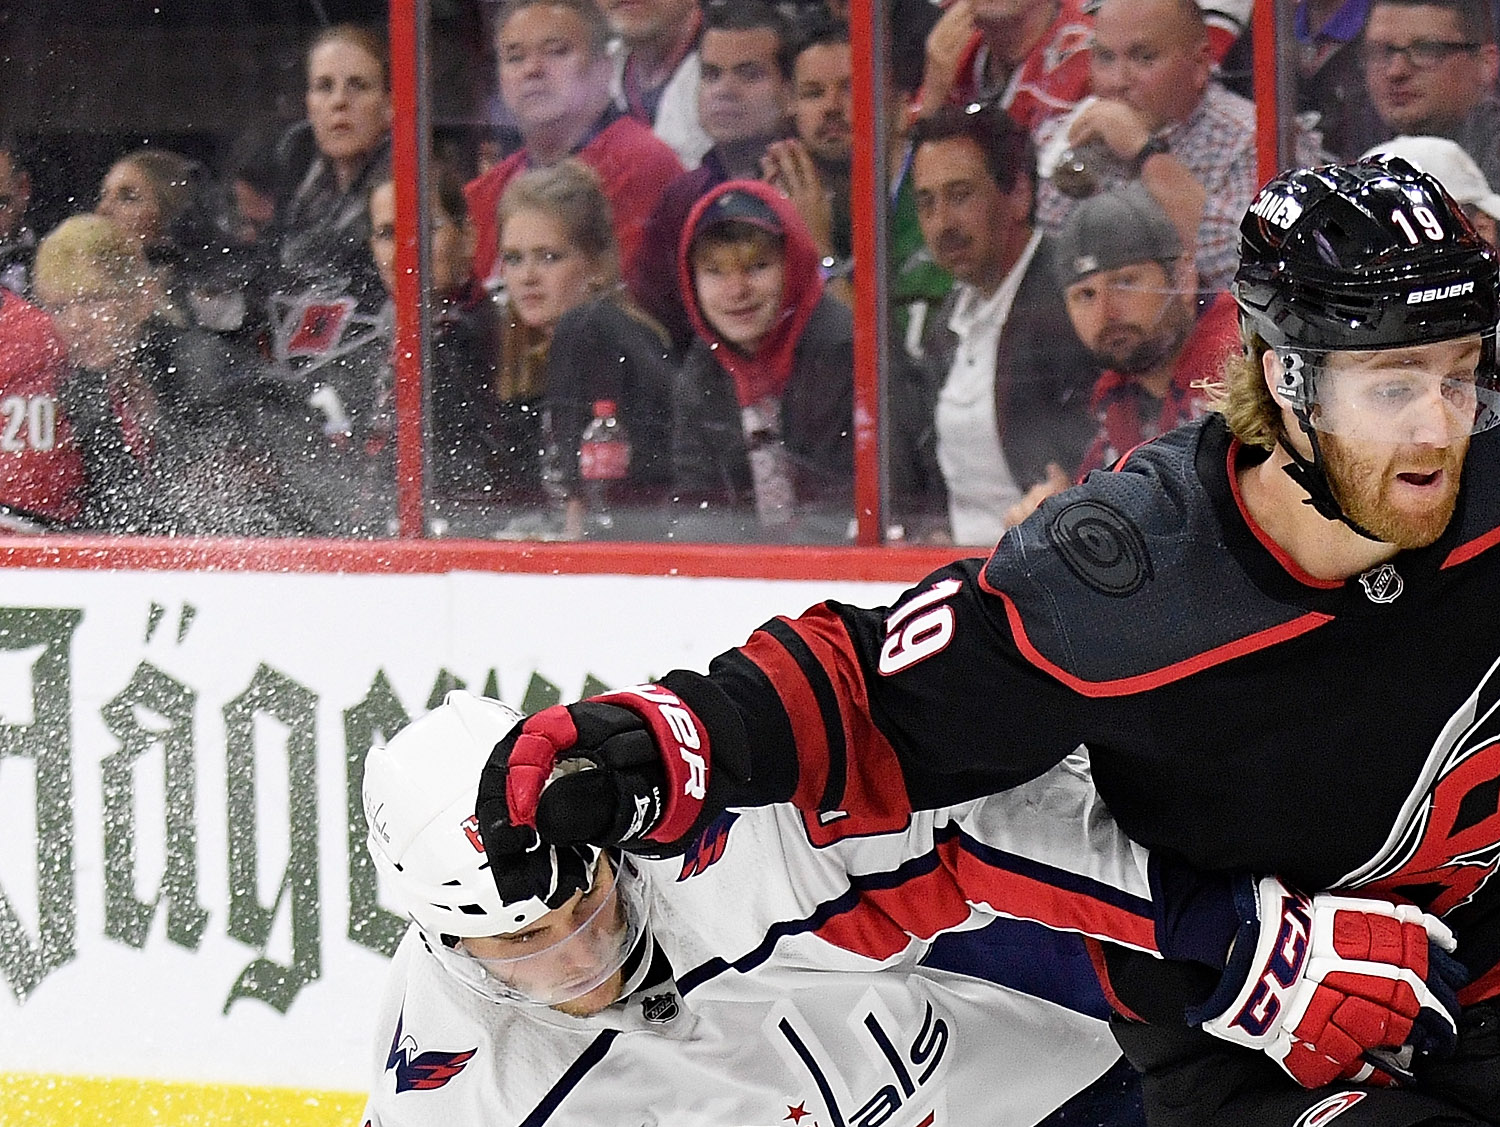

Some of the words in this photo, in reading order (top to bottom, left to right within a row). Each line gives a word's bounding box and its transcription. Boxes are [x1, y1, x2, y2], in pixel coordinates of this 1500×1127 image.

[1391, 205, 1445, 245] 19
[1406, 281, 1475, 304] BAUER
[1, 395, 56, 453] 20
[877, 577, 963, 677] 19
